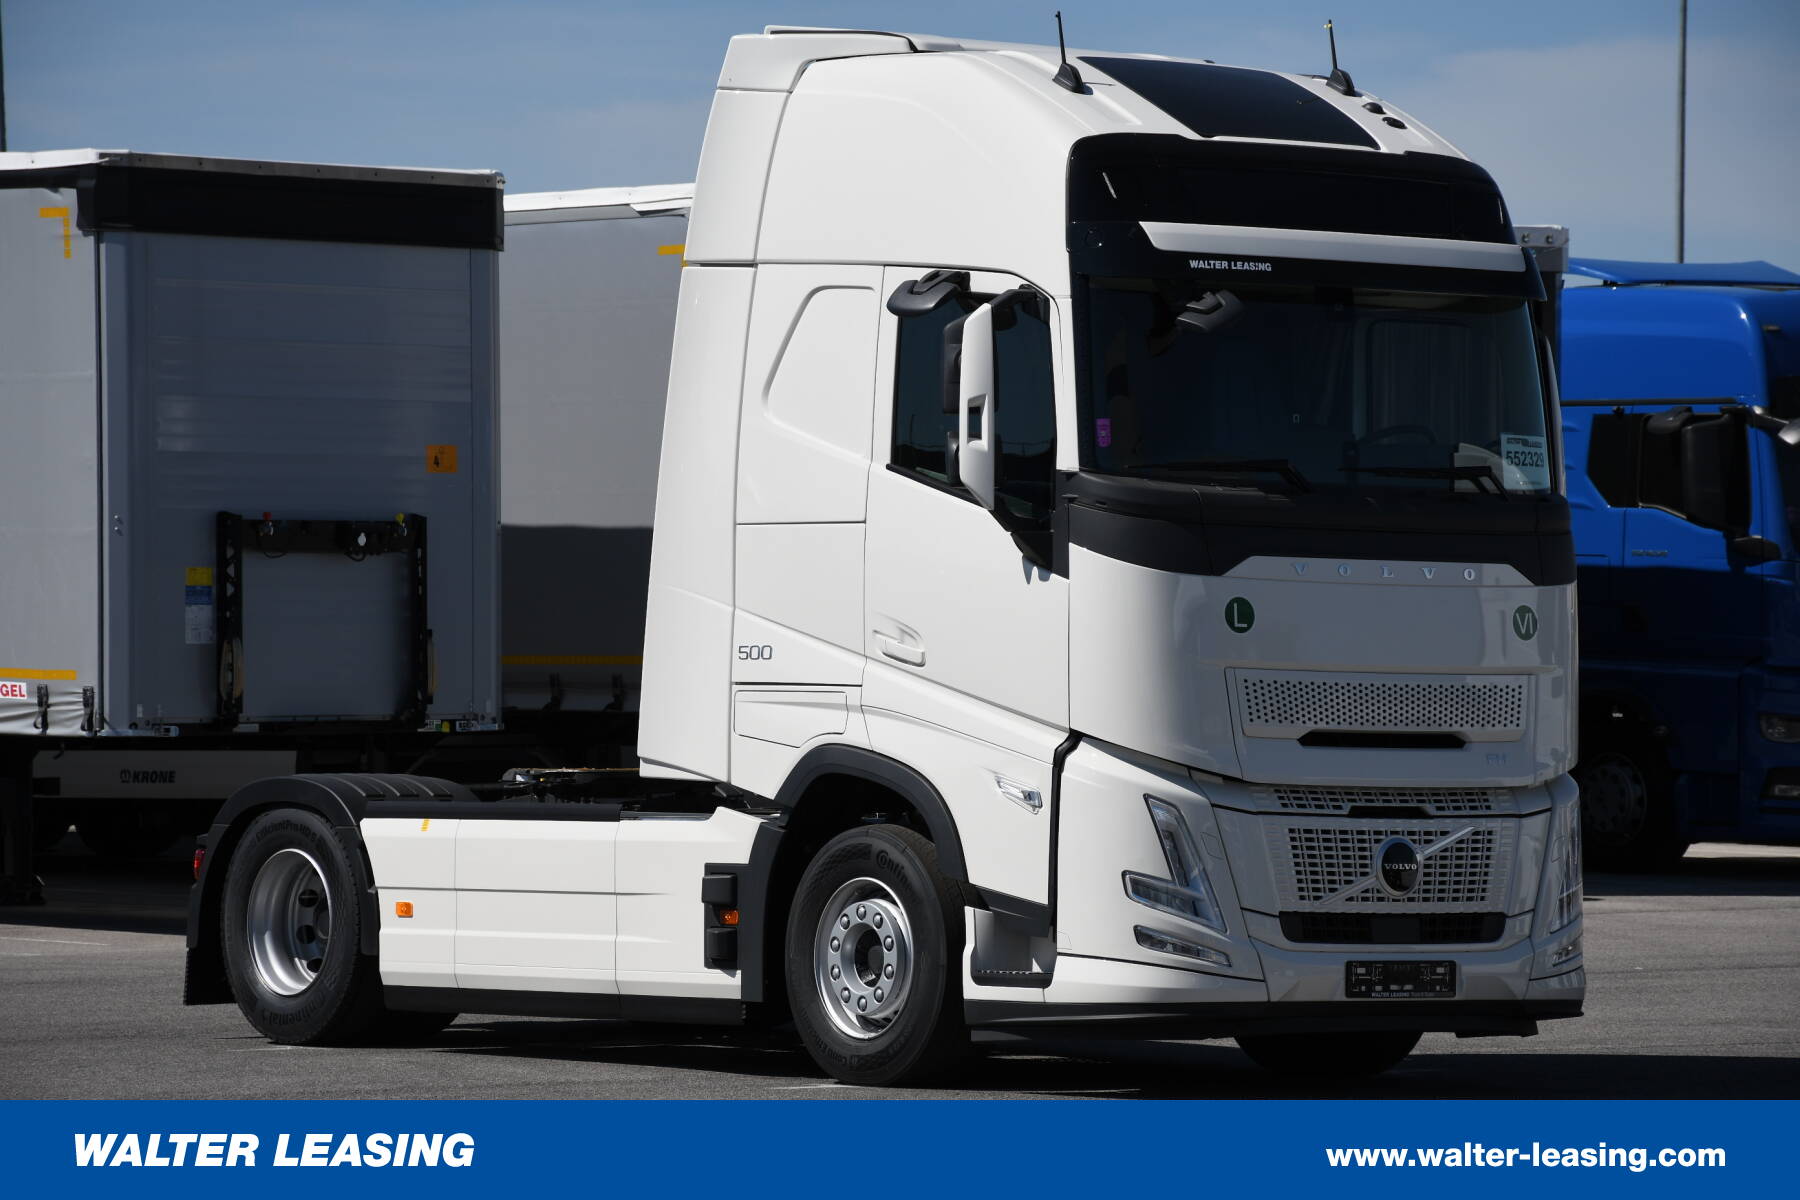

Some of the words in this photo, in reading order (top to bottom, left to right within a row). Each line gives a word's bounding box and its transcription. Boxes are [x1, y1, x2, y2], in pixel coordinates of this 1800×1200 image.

[1189, 259, 1229, 270] WALTER
[1231, 261, 1272, 272] LEASING
[1291, 562, 1476, 581] VOLVO
[1233, 602, 1248, 628] L
[1515, 612, 1534, 635] VI
[738, 645, 773, 661] 500
[0, 683, 26, 698] GEL
[132, 769, 177, 785] KRONE
